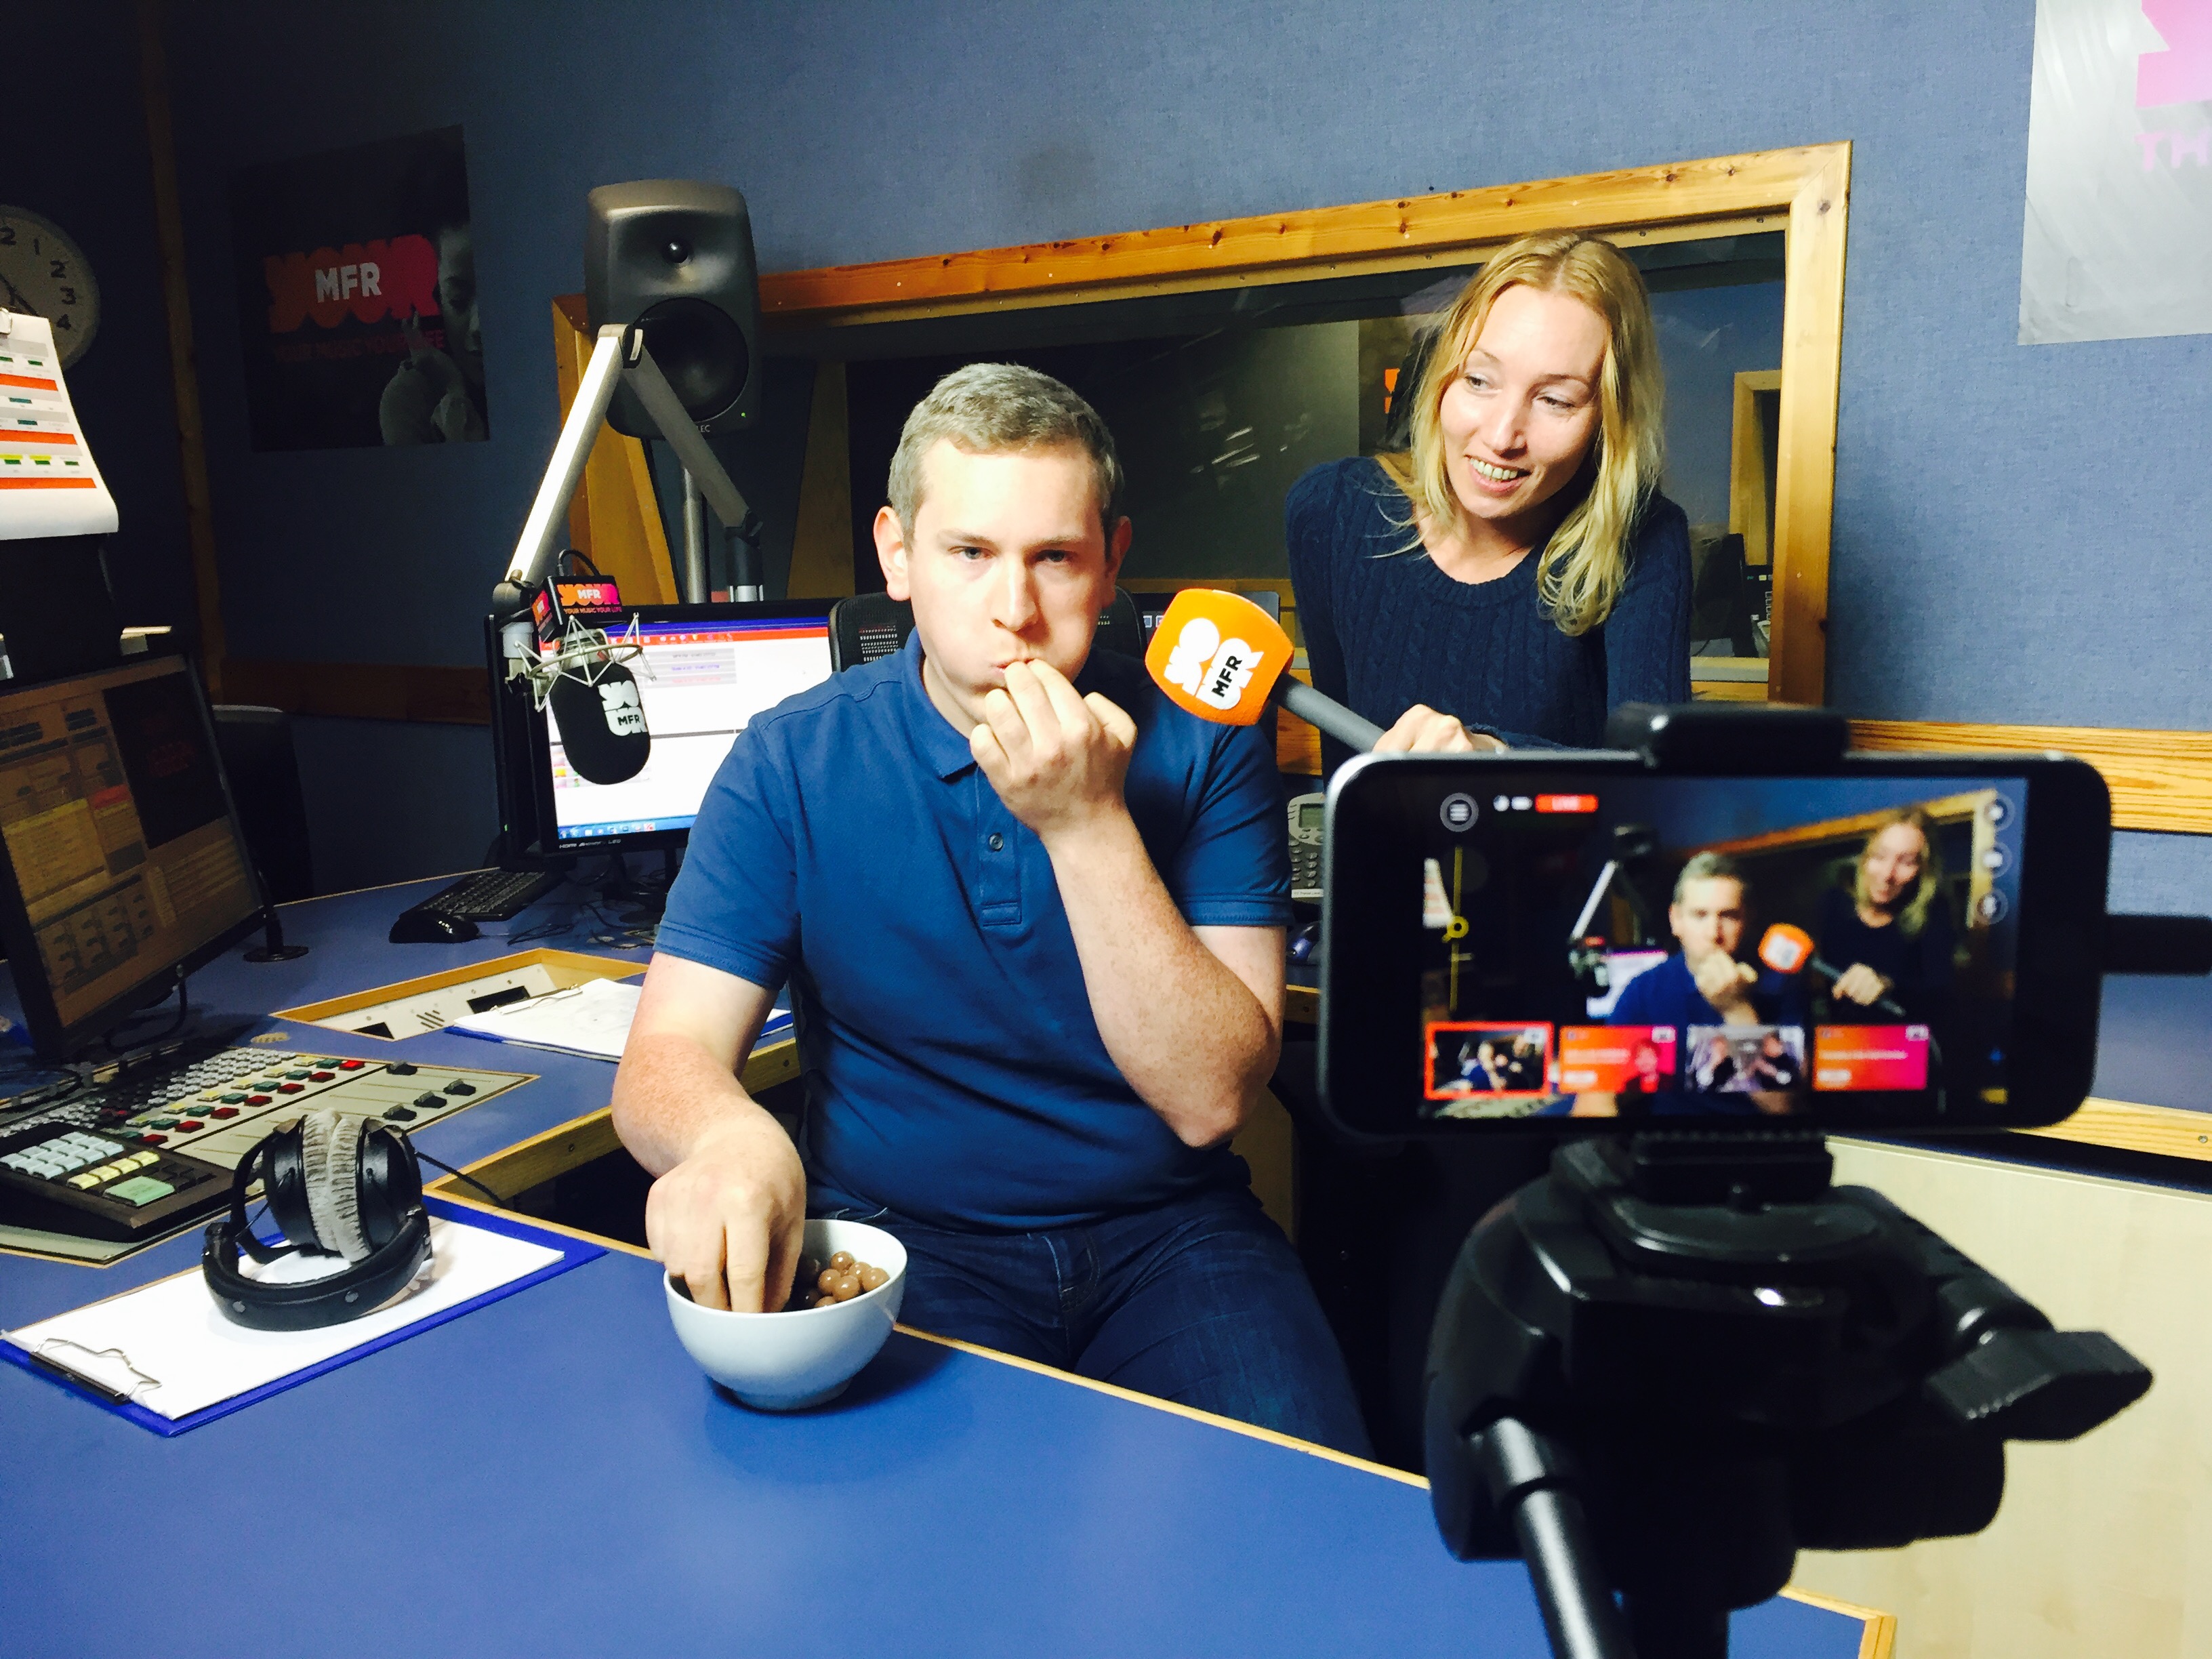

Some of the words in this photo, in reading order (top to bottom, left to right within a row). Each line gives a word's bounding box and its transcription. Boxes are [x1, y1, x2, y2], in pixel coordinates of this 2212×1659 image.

[33, 238, 41, 255] 1
[49, 260, 68, 279] 2
[314, 262, 382, 304] MFR
[60, 286, 77, 305] 3
[56, 313, 71, 331] 4
[577, 589, 602, 599] MFR
[1211, 655, 1242, 697] MFR
[617, 714, 640, 726] MFR
